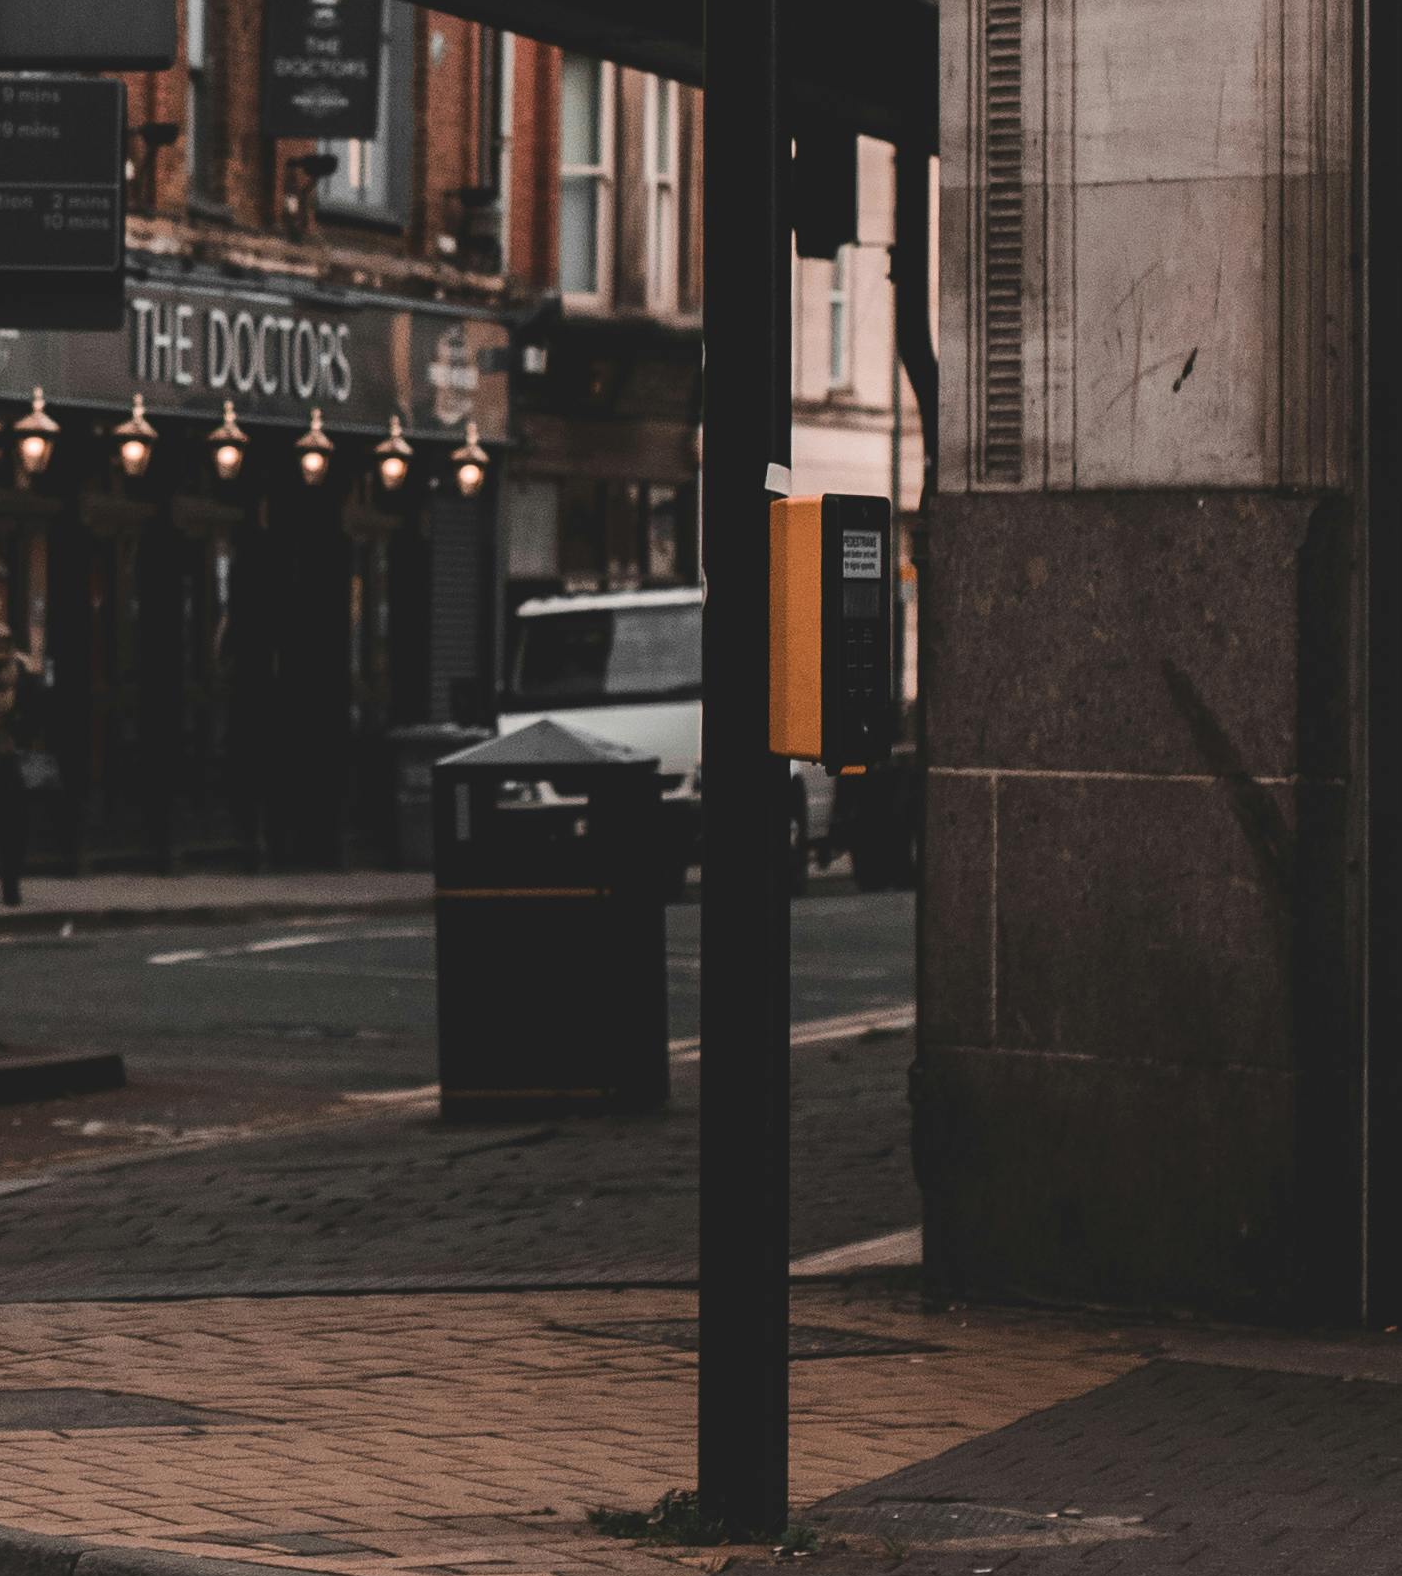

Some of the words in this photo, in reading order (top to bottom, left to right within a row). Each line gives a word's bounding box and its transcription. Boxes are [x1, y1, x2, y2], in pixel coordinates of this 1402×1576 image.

[1, 86, 15, 103] 9
[18, 86, 62, 103] mins
[18, 120, 62, 140] mins
[52, 193, 64, 210] 2
[67, 193, 111, 210] mins
[43, 212, 64, 230] 10
[67, 213, 111, 230] mins
[132, 298, 195, 386] THE
[208, 308, 352, 401] DOCTORS
